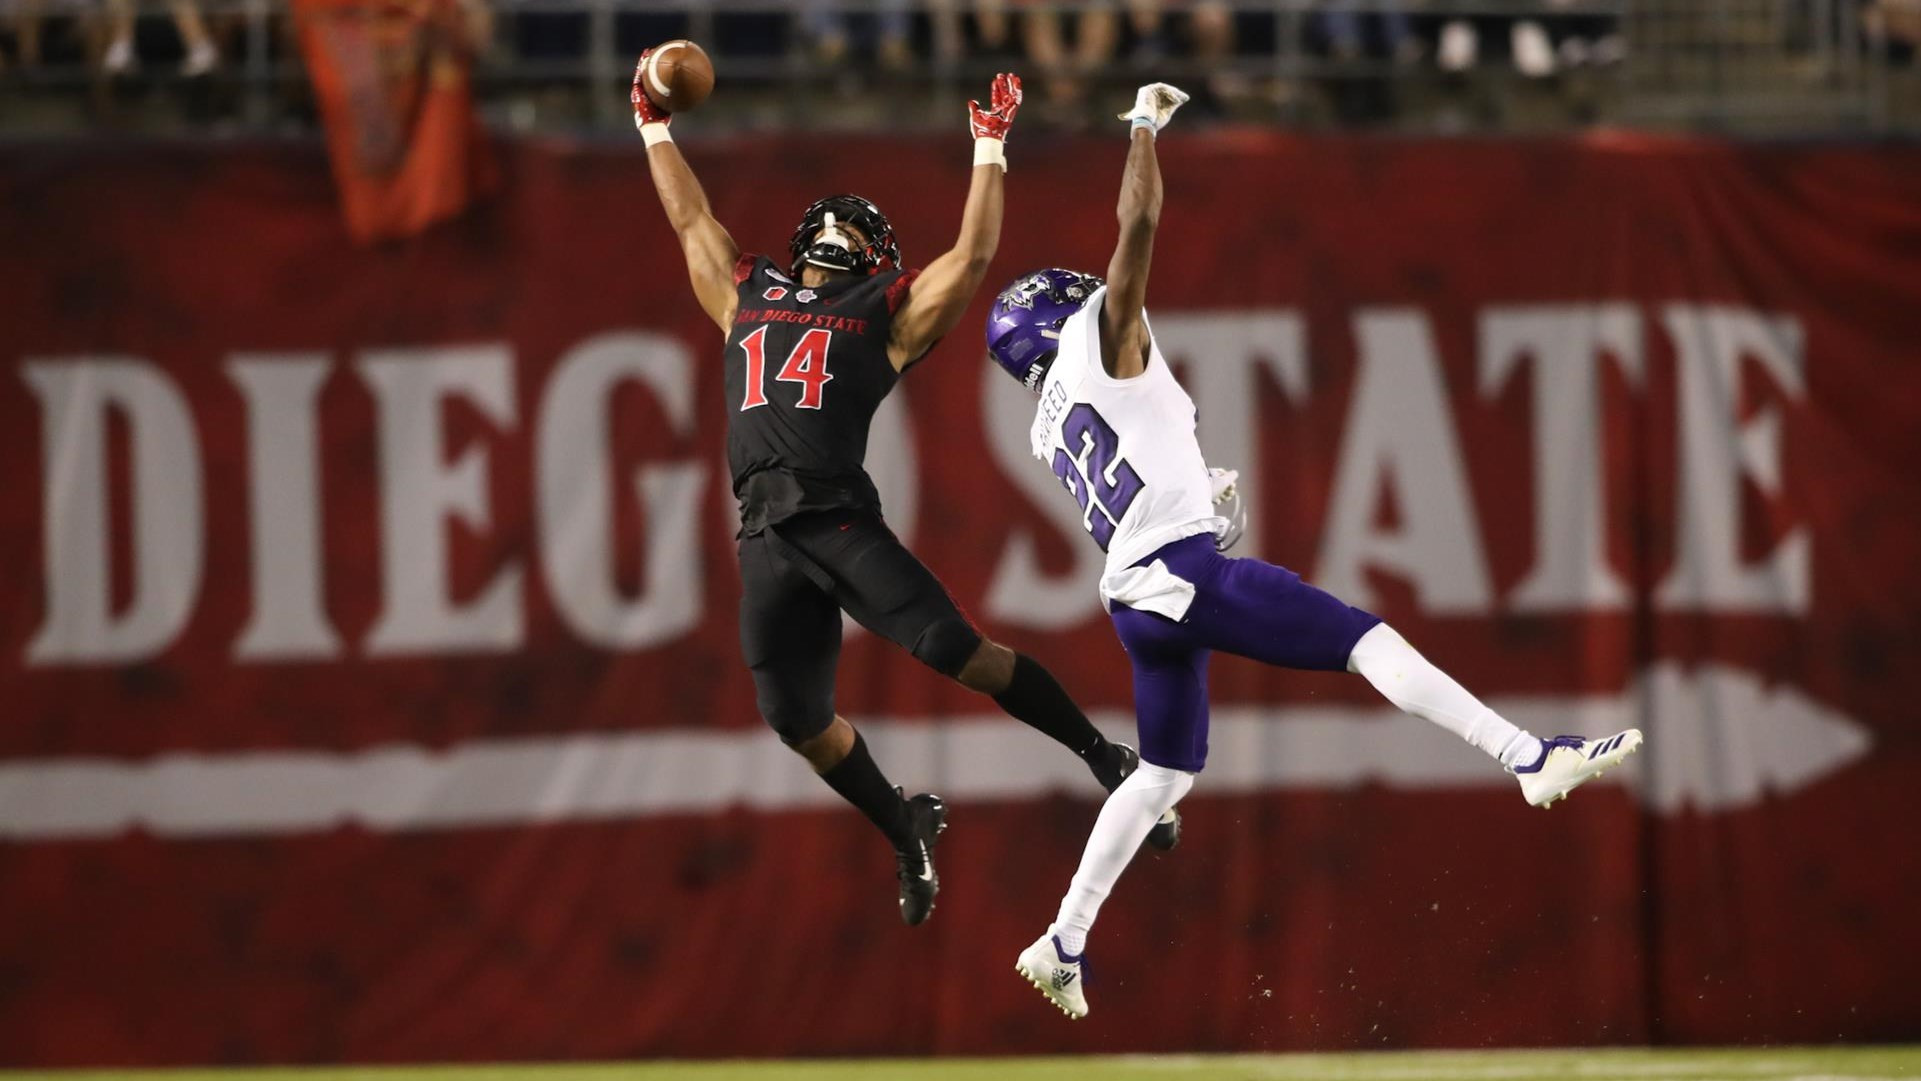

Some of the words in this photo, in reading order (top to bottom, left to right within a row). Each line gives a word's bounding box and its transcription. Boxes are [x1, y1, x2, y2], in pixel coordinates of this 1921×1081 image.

[760, 309, 812, 325] DIEGO
[812, 314, 868, 335] STATE
[739, 324, 834, 412] 14
[1052, 402, 1146, 554] 22
